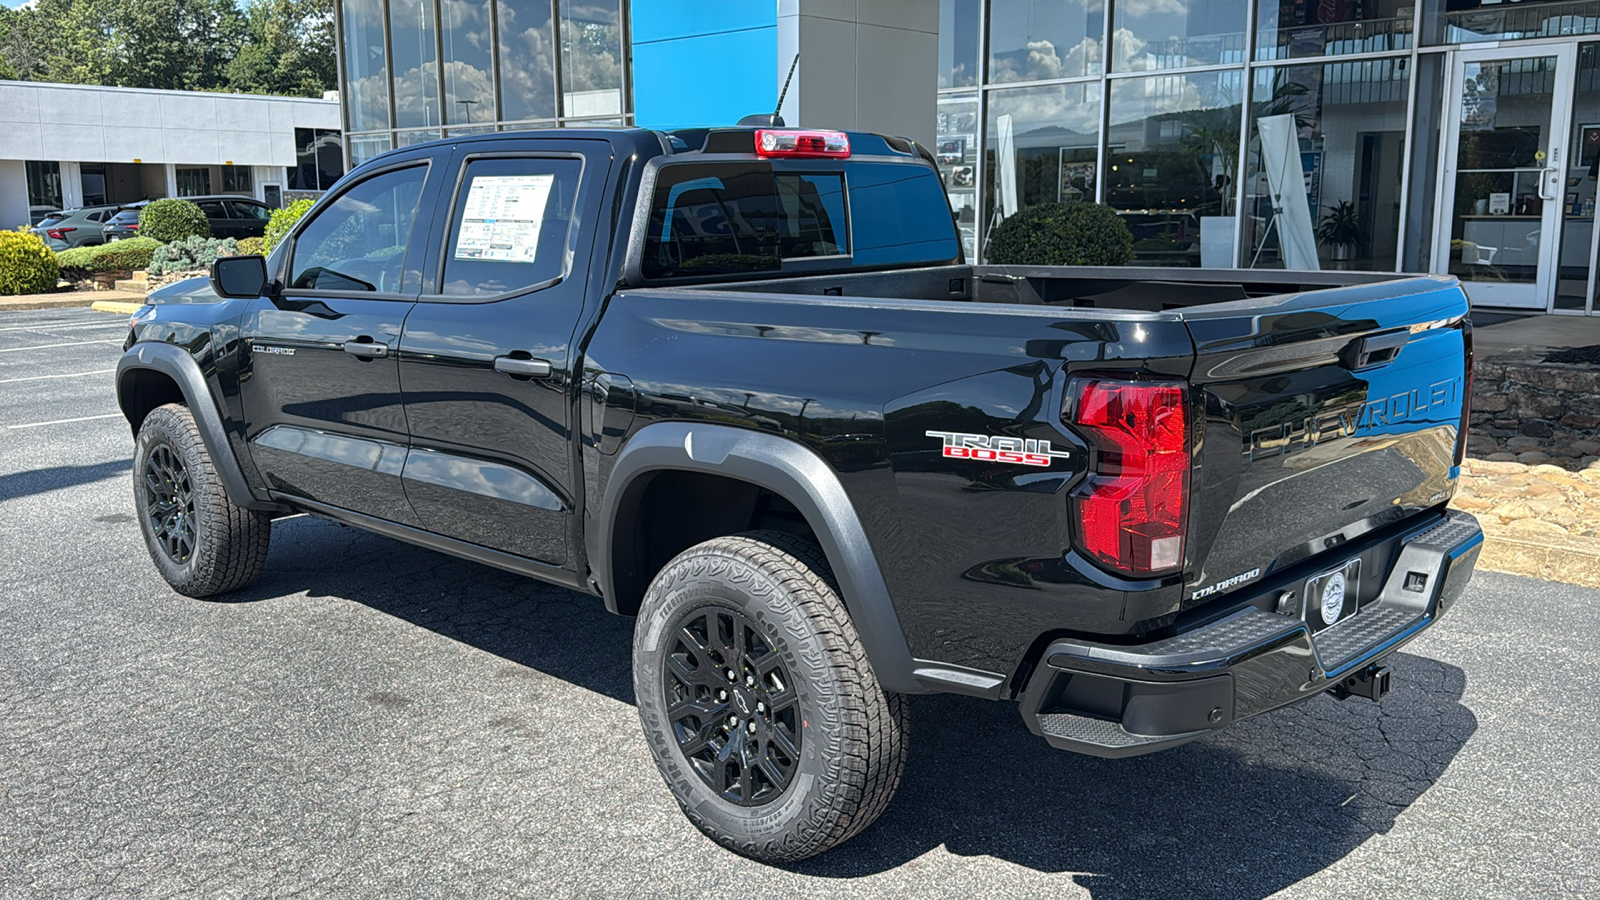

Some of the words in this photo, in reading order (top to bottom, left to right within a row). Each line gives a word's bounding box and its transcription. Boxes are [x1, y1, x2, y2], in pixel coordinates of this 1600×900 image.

[1310, 154, 1320, 206] CHEVROLET
[252, 345, 296, 356] COLORADO
[1250, 375, 1462, 462] CHEVROLET
[925, 430, 1070, 459] TRAIL
[942, 445, 1051, 467] BOSS
[1191, 567, 1261, 601] COLORADO
